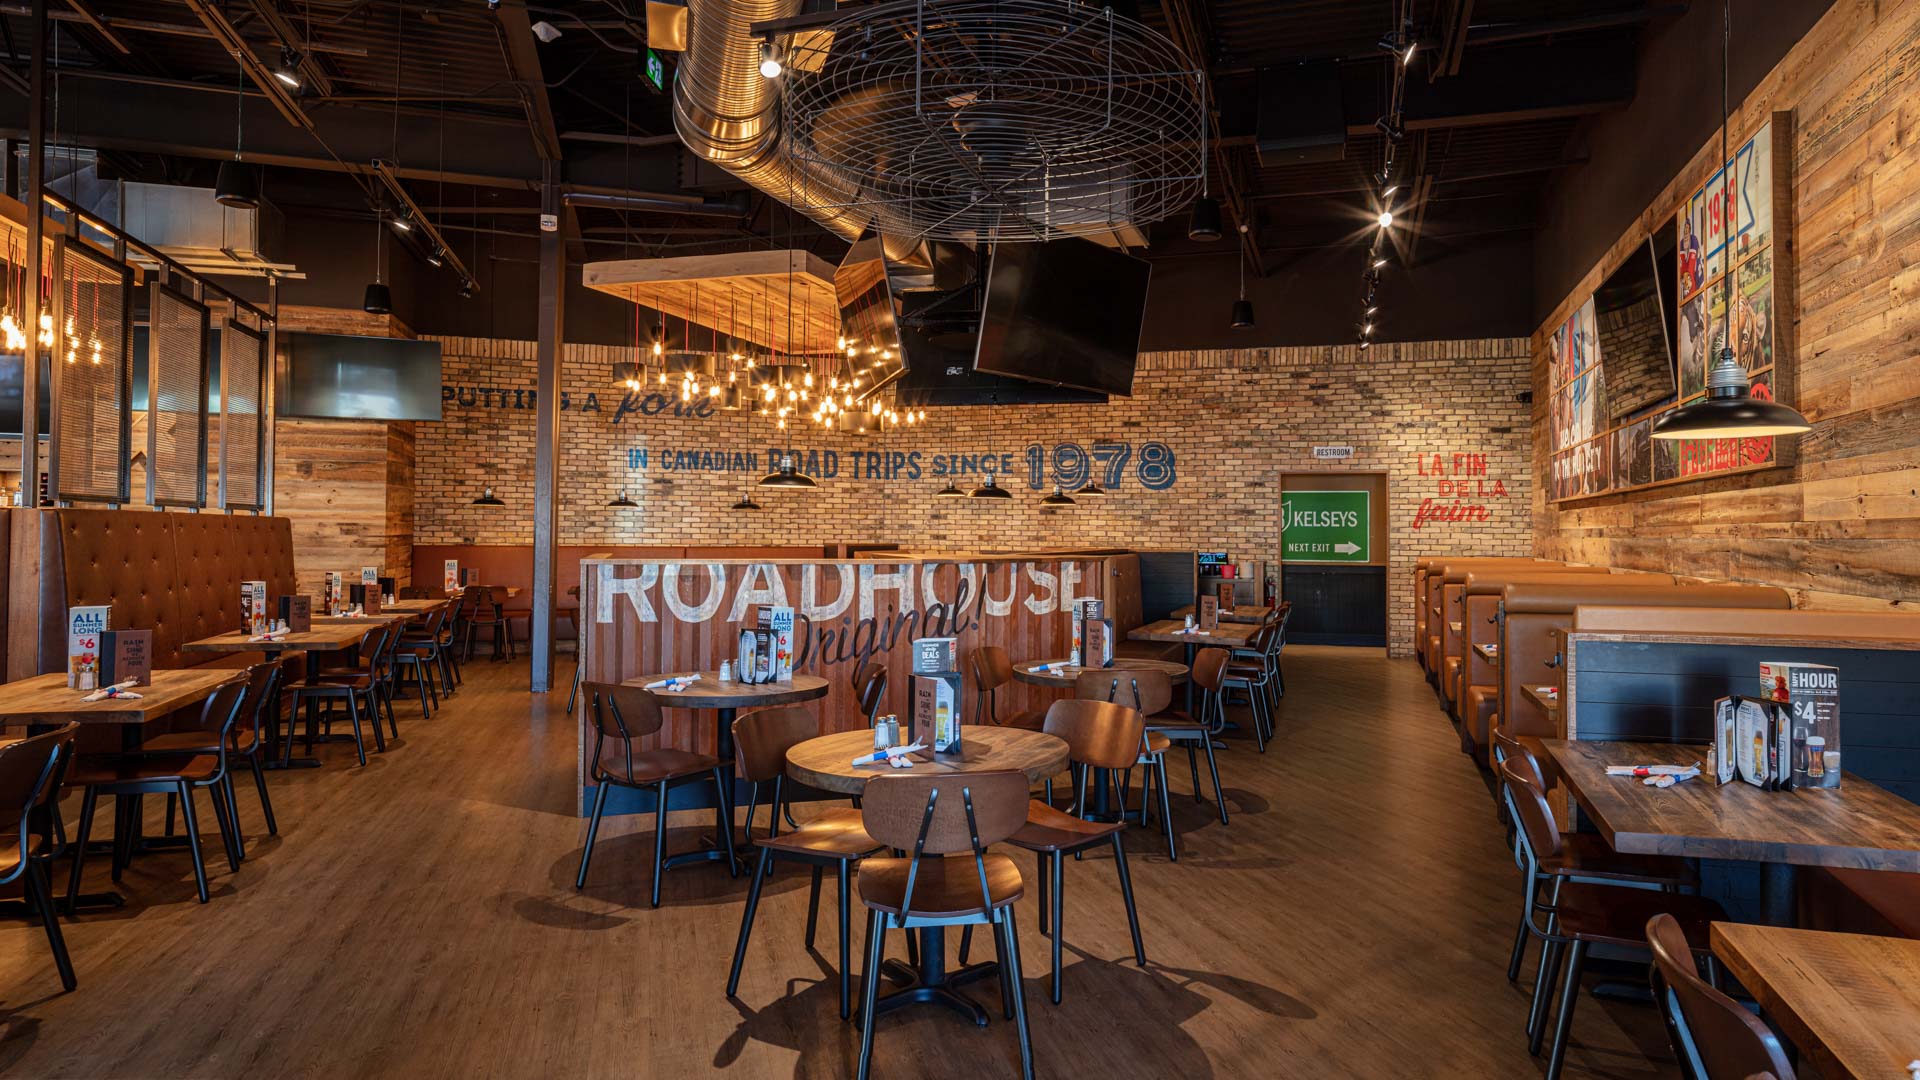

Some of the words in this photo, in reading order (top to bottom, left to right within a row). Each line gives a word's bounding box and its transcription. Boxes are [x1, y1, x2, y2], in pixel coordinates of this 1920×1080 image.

[582, 392, 602, 412] A
[1316, 448, 1351, 457] RESTROOM
[629, 448, 648, 469] IN
[661, 450, 758, 471] CANADIAN
[768, 448, 838, 478] ROAD
[849, 451, 922, 479] TRIPS
[932, 453, 1013, 476] SINCE
[1026, 442, 1177, 490] 1978
[1418, 453, 1443, 476] LA
[1453, 453, 1486, 476] FIN
[1439, 480, 1469, 497] DE
[1478, 480, 1508, 497] LA
[1294, 511, 1358, 527] KELSEYS
[1413, 498, 1490, 529] faim
[1288, 543, 1310, 552] NEXT
[1312, 543, 1330, 552] EXIT
[73, 613, 102, 623] ALL
[774, 612, 792, 621] ALL
[79, 639, 95, 649] $6
[1800, 673, 1837, 688] HOUR
[1795, 701, 1816, 724] $4
